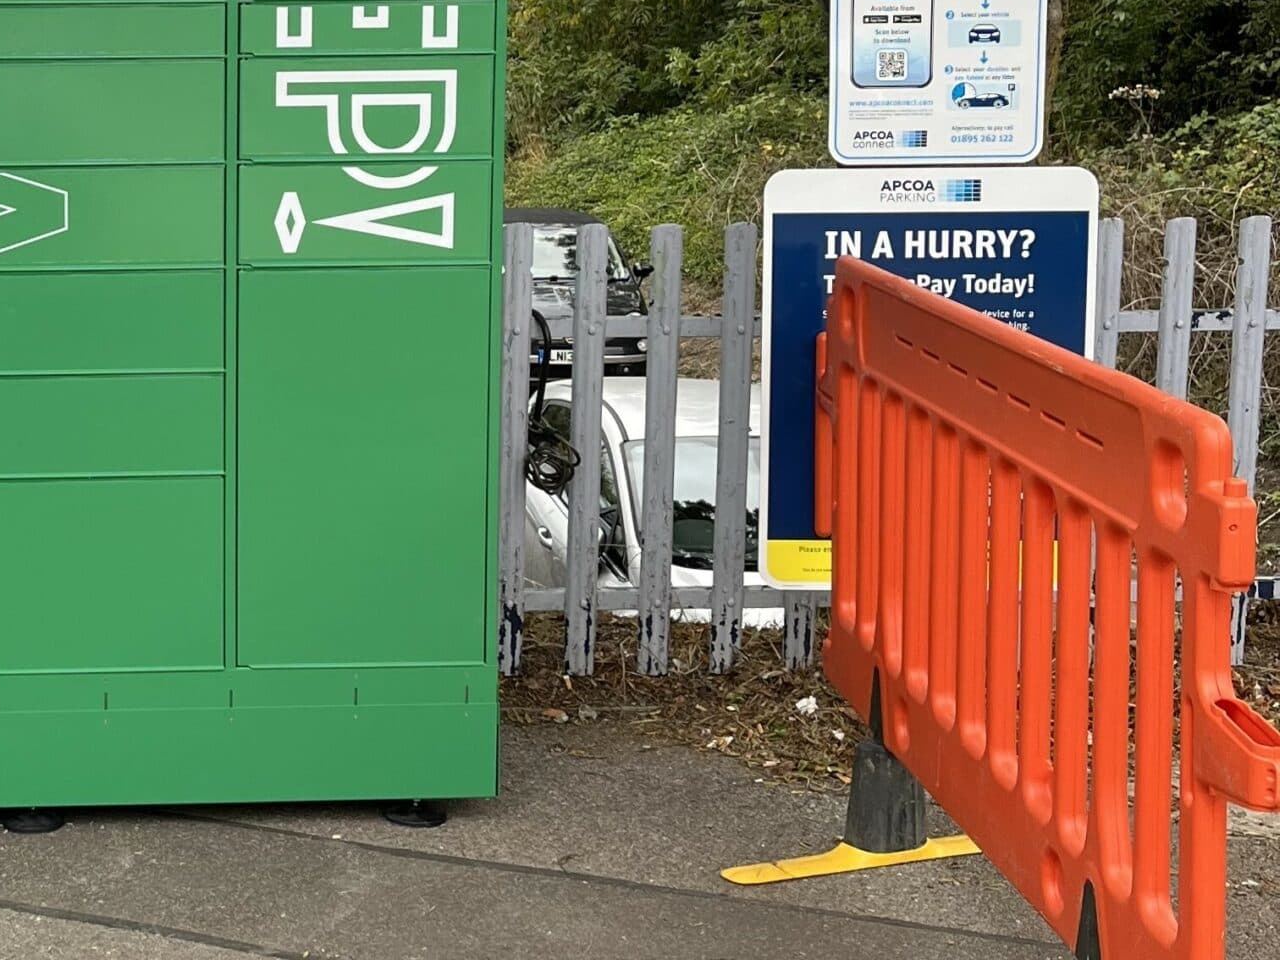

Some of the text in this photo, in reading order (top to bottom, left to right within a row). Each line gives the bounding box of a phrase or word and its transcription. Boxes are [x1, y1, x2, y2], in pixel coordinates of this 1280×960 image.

[854, 131, 893, 139] APCOA
[951, 135, 977, 143] 01895
[999, 134, 1013, 142] 122
[853, 140, 894, 148] connect
[880, 180, 935, 192] APCOA
[879, 192, 935, 202] PARKING
[824, 229, 1035, 259] IN A HURRY?
[963, 274, 1035, 298] Today!
[1013, 309, 1025, 317] for
